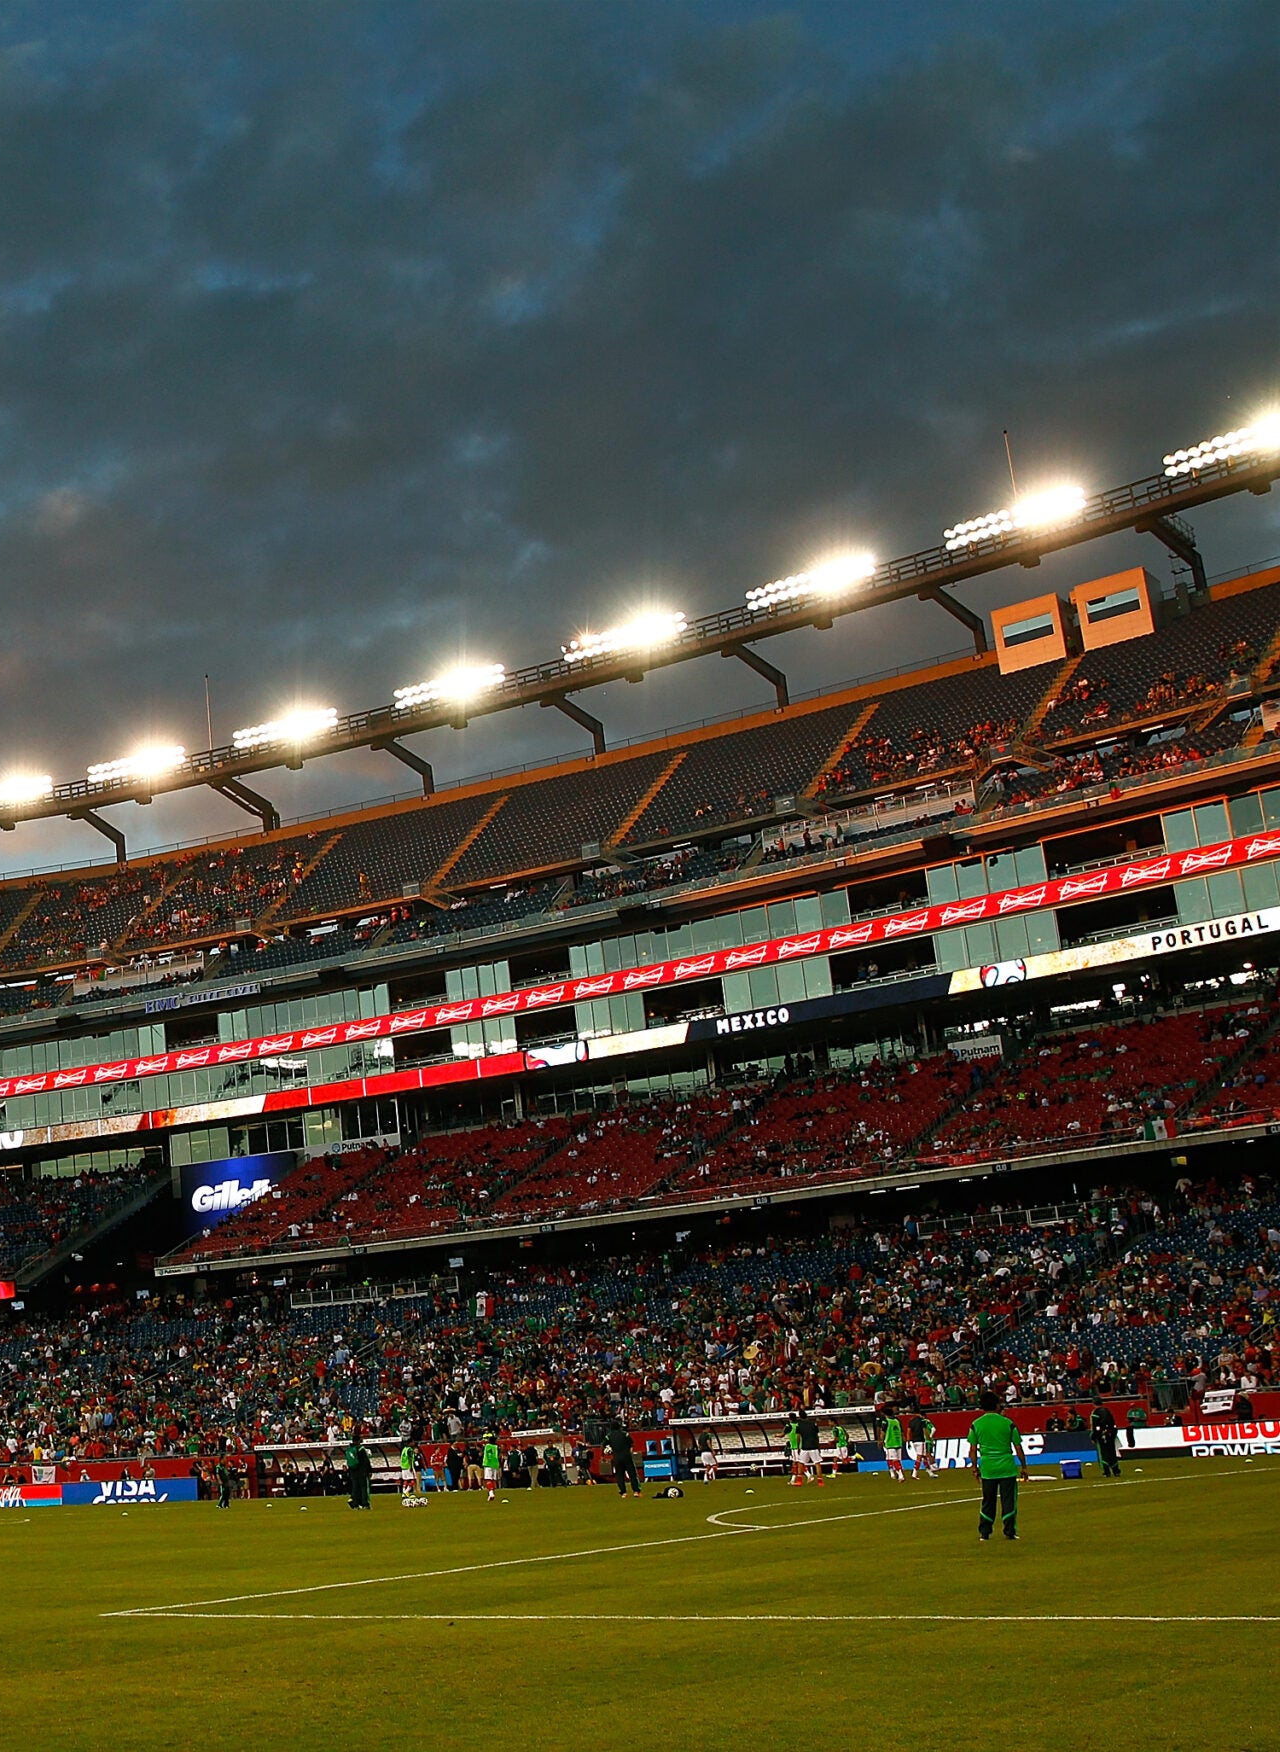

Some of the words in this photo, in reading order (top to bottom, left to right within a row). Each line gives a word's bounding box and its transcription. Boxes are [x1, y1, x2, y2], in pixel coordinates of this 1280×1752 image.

[1151, 915, 1269, 951] PORTUGAL
[716, 1008, 790, 1035] MEXICO
[960, 1044, 1000, 1057] Putnam
[100, 1480, 156, 1497] VISA
